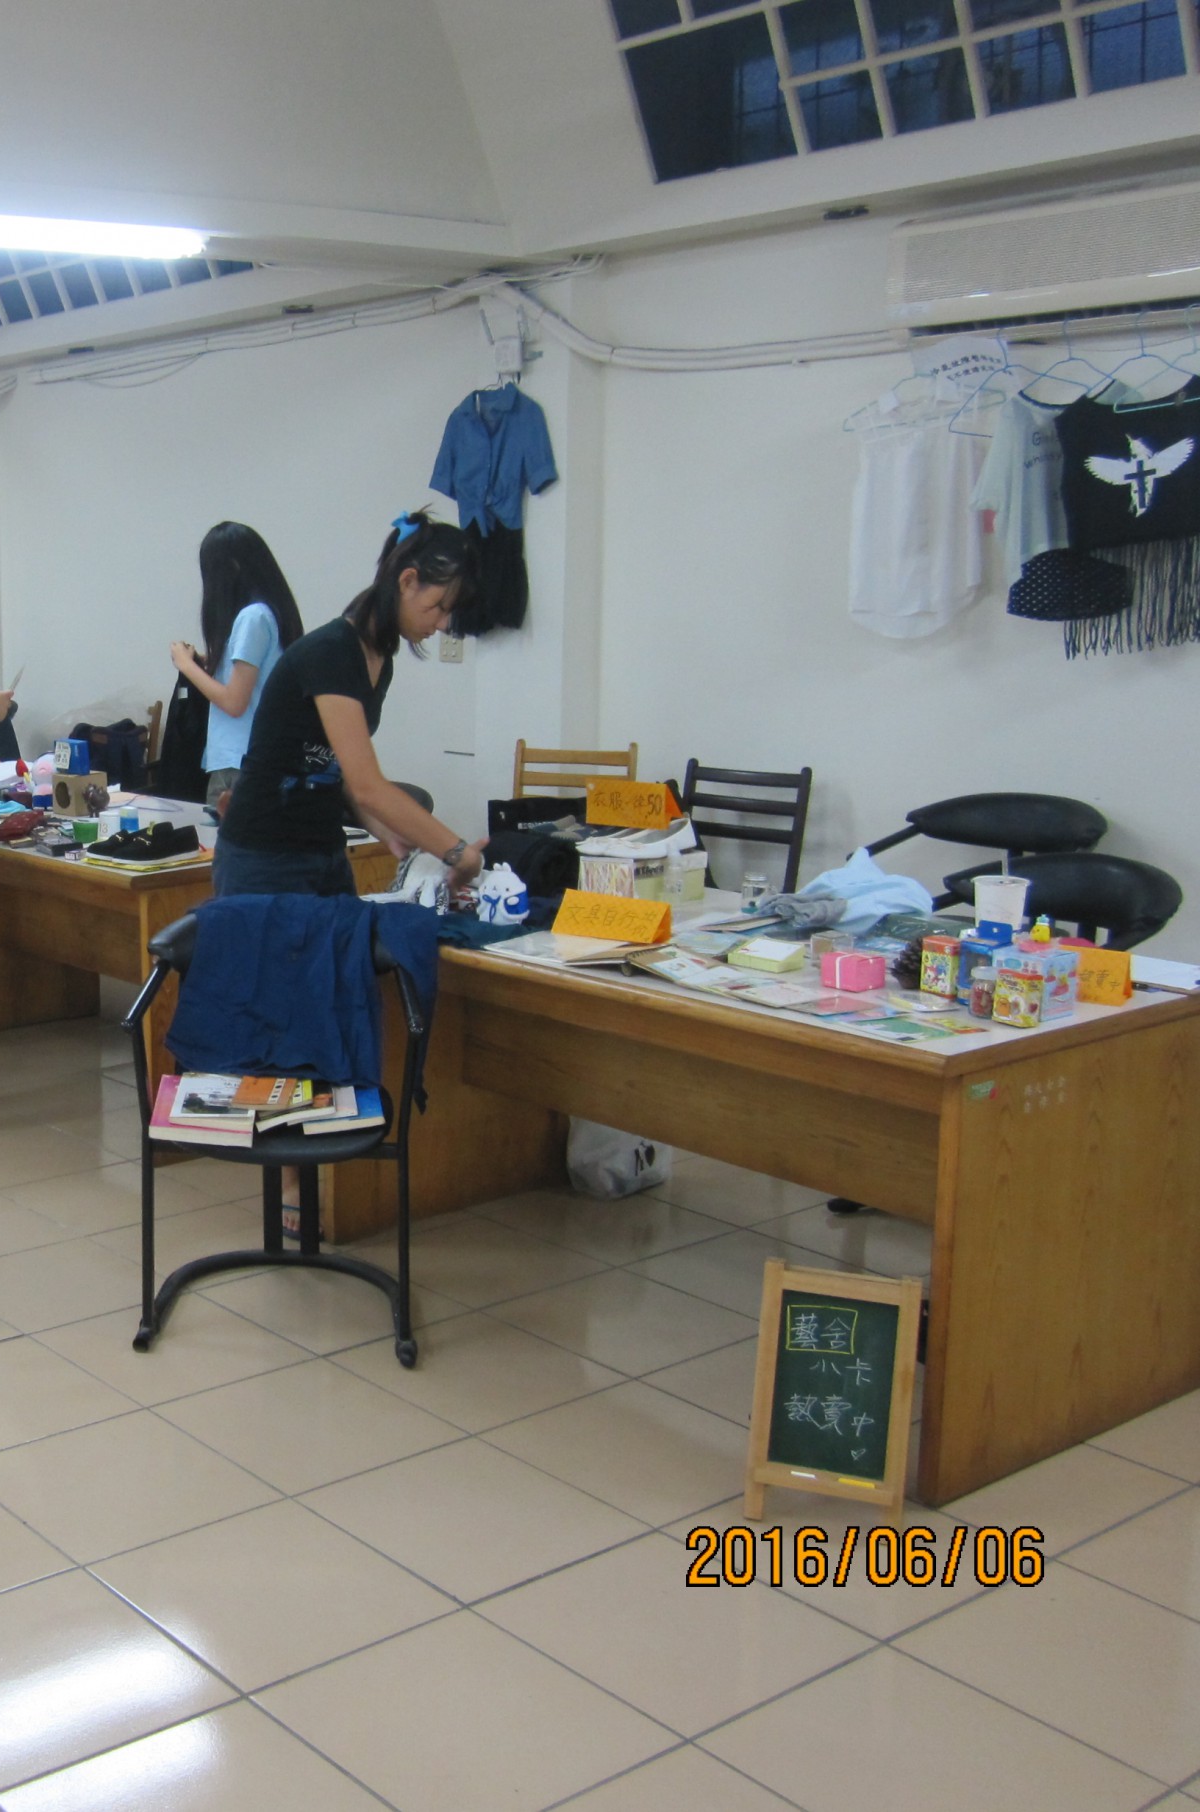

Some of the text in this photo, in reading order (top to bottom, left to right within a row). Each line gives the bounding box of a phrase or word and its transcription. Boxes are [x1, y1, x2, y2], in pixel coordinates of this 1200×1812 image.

[809, 1358, 872, 1386] 小卡
[783, 1393, 875, 1437] 熱賣中
